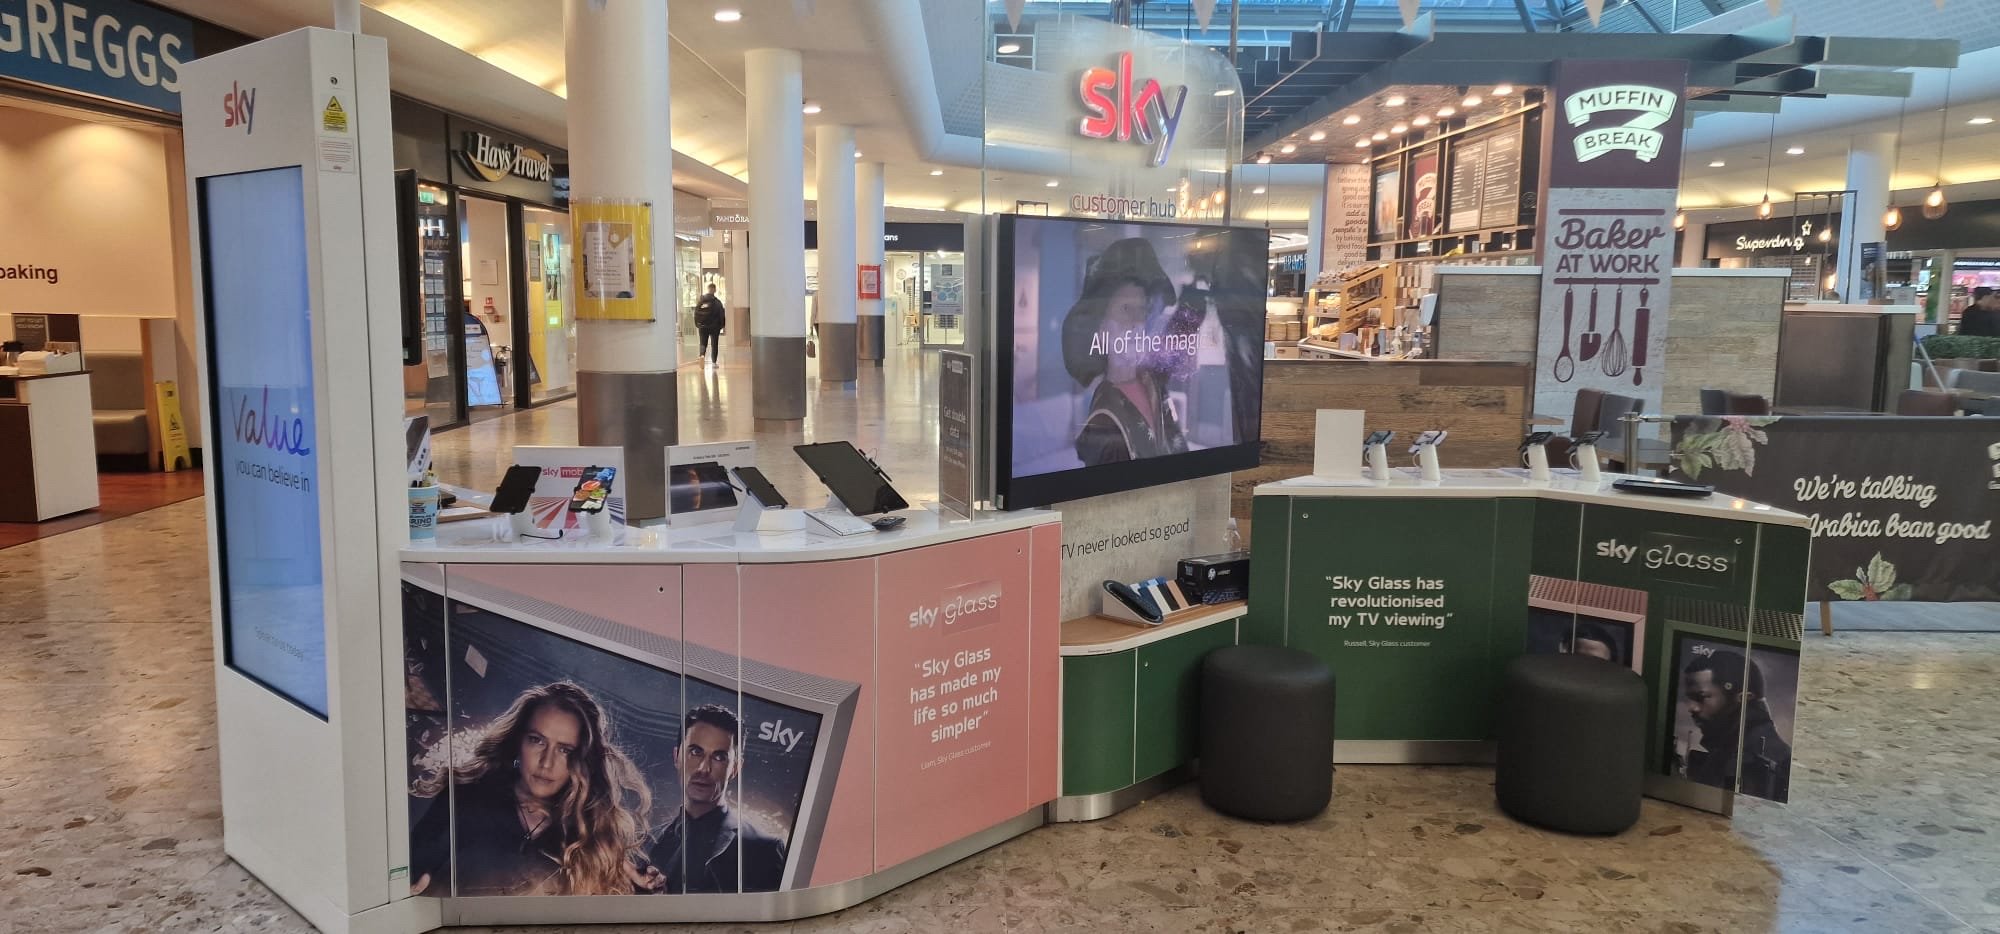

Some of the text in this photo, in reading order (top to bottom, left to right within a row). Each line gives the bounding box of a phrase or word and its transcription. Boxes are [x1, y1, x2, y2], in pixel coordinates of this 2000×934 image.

[0, 0, 181, 93] GREGGS
[223, 80, 256, 135] sky
[1079, 51, 1188, 168] sky
[1579, 89, 1664, 110] MUFFIN
[1584, 131, 1654, 149] BREAK
[476, 133, 550, 182] Hays Travel
[1072, 192, 1176, 218] customer hub
[1555, 218, 1666, 250] Baker
[1556, 254, 1660, 274] AT WORK
[1089, 332, 1109, 356] All
[1113, 330, 1131, 354] of
[1135, 332, 1161, 353] the
[229, 384, 310, 457] Value
[235, 460, 310, 493] you can believe in
[543, 467, 559, 477] sky
[1793, 474, 1938, 509] We're talking
[1061, 517, 1190, 561] TV never looked so good
[1885, 513, 1935, 538] bean
[1936, 520, 1992, 545] good
[1596, 538, 1729, 572] sky glass
[1368, 576, 1411, 590] Glass
[1416, 576, 1444, 590] has
[908, 592, 1000, 629] sky glass
[1330, 594, 1444, 608] revolutionised
[1328, 614, 1352, 629] my
[1356, 612, 1380, 626] TV
[954, 647, 991, 669] Glass
[1368, 640, 1380, 648] Sky
[1692, 644, 1716, 658] sky
[910, 666, 1002, 704] has made my
[913, 686, 998, 726] life so much
[758, 719, 804, 753] sky
